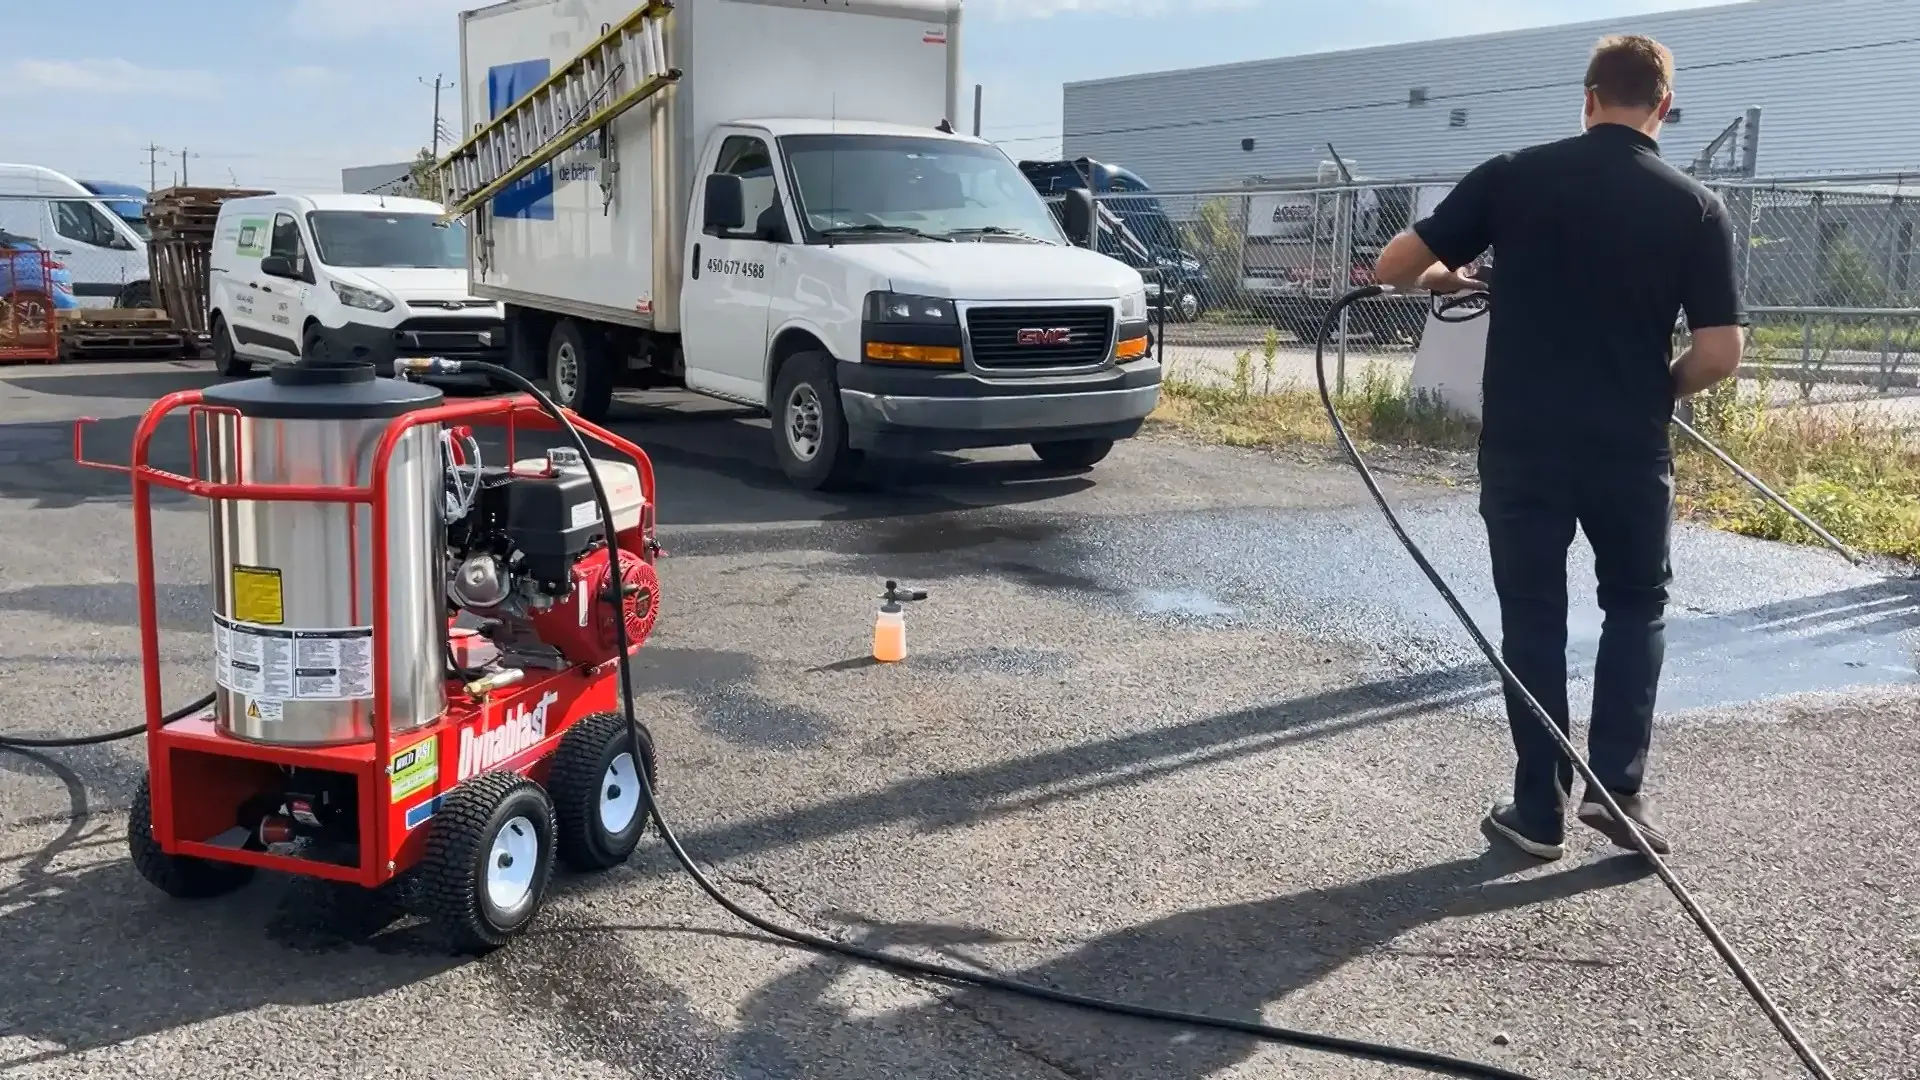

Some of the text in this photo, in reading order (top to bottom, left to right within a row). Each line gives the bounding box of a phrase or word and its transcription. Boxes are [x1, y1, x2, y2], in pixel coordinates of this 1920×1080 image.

[571, 162, 597, 181] bâtim
[707, 258, 765, 279] 450 677 4588
[1017, 327, 1071, 344] GMC
[457, 690, 558, 781] Dynablast
